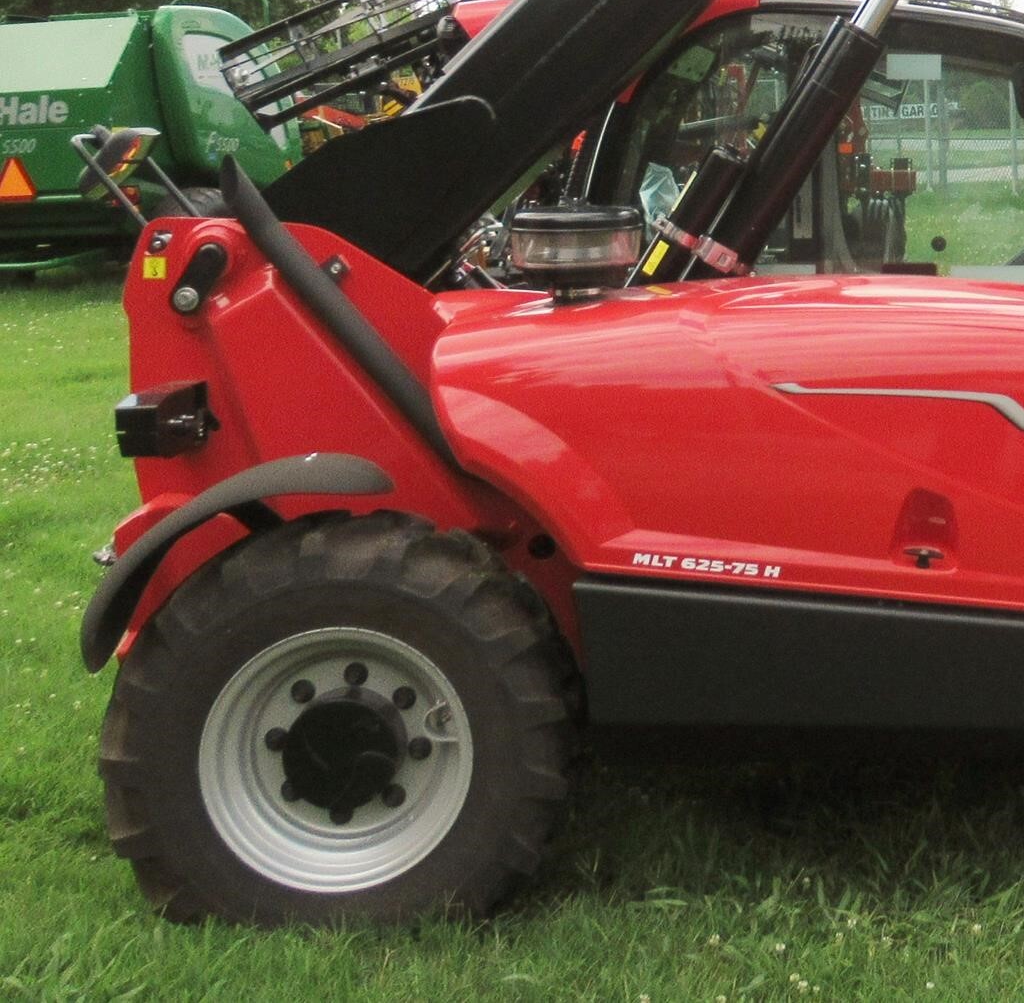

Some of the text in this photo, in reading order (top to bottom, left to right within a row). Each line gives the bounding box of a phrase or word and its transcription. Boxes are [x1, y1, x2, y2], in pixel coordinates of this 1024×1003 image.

[632, 553, 781, 578] MLT 625-75 H
